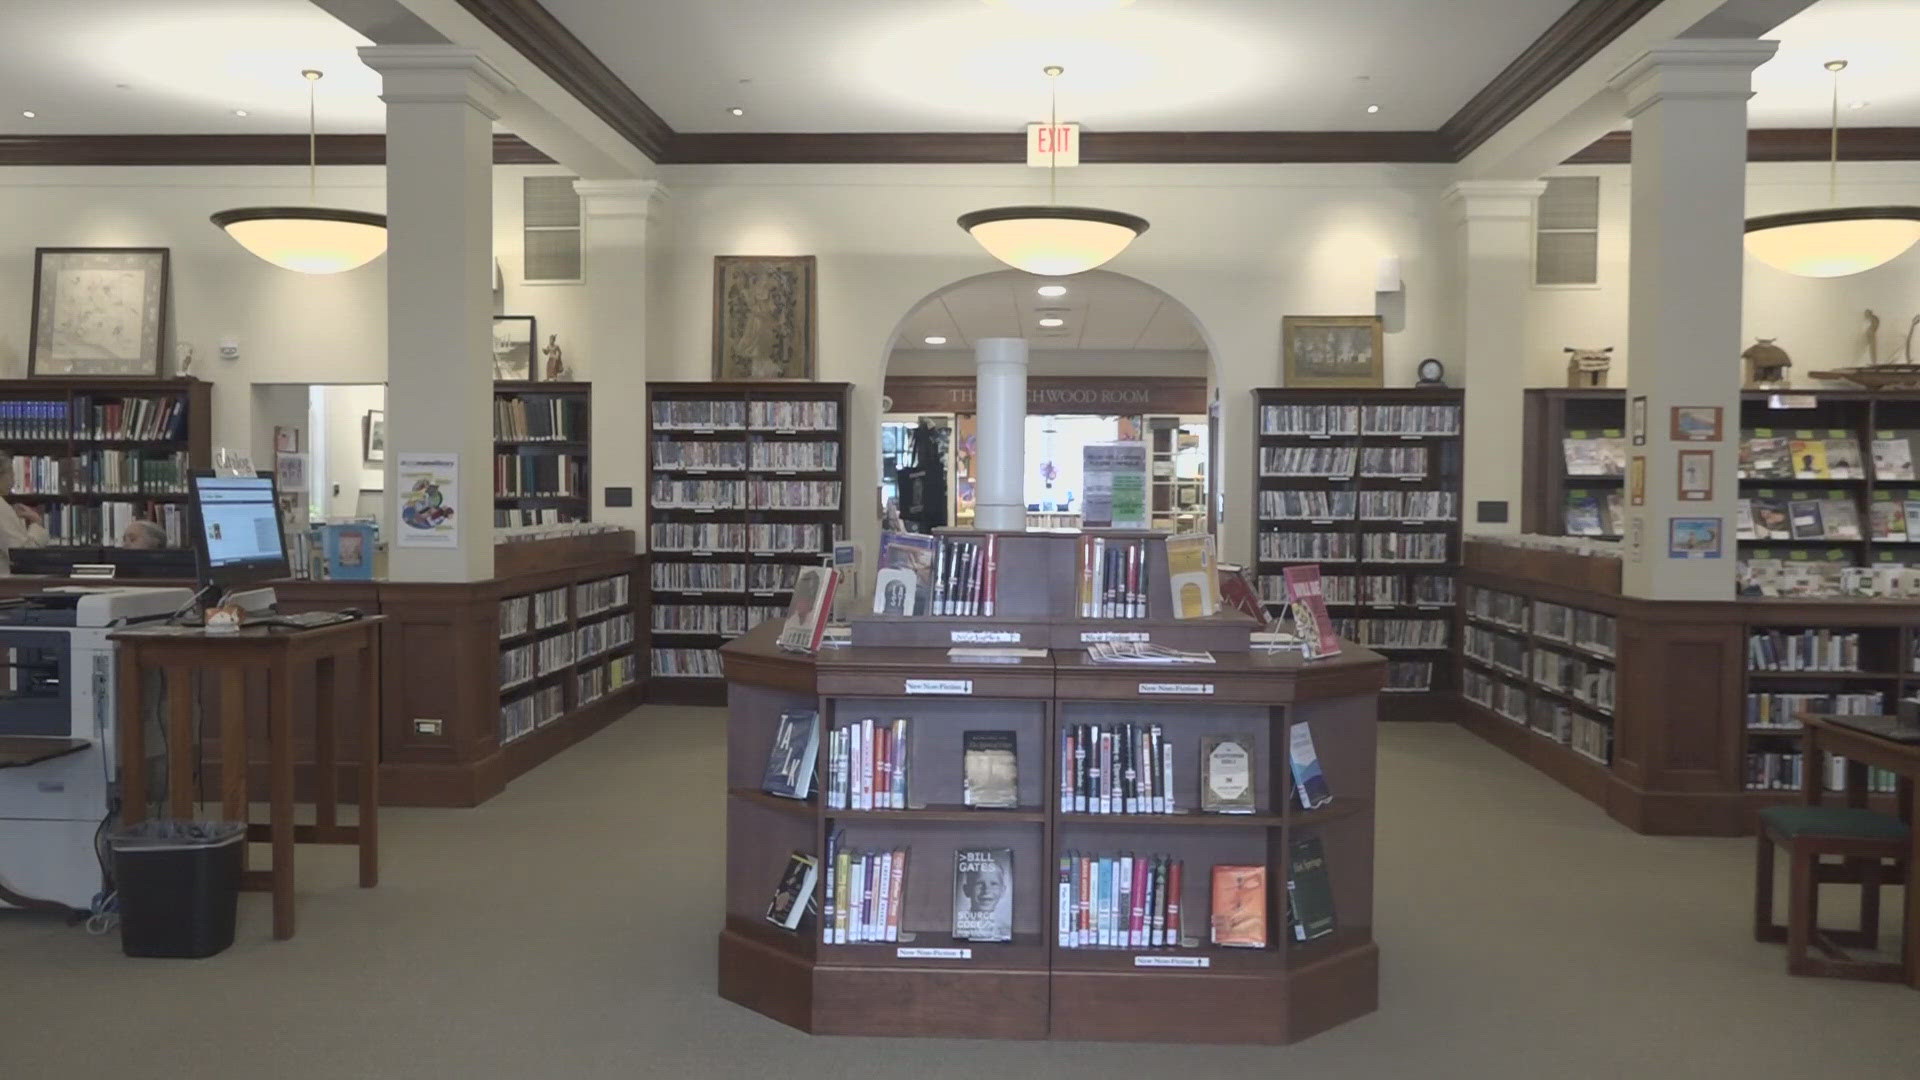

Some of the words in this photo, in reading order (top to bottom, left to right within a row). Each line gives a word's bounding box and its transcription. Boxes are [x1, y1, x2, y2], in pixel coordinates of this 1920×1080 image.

[1038, 127, 1071, 153] EXIT
[951, 389, 976, 402] TH
[1101, 389, 1149, 402] ROOM
[923, 683, 962, 691] Non-Fiction
[1158, 684, 1199, 692] Non-Fiction
[959, 862, 996, 872] GATES
[957, 911, 994, 920] SOURCE
